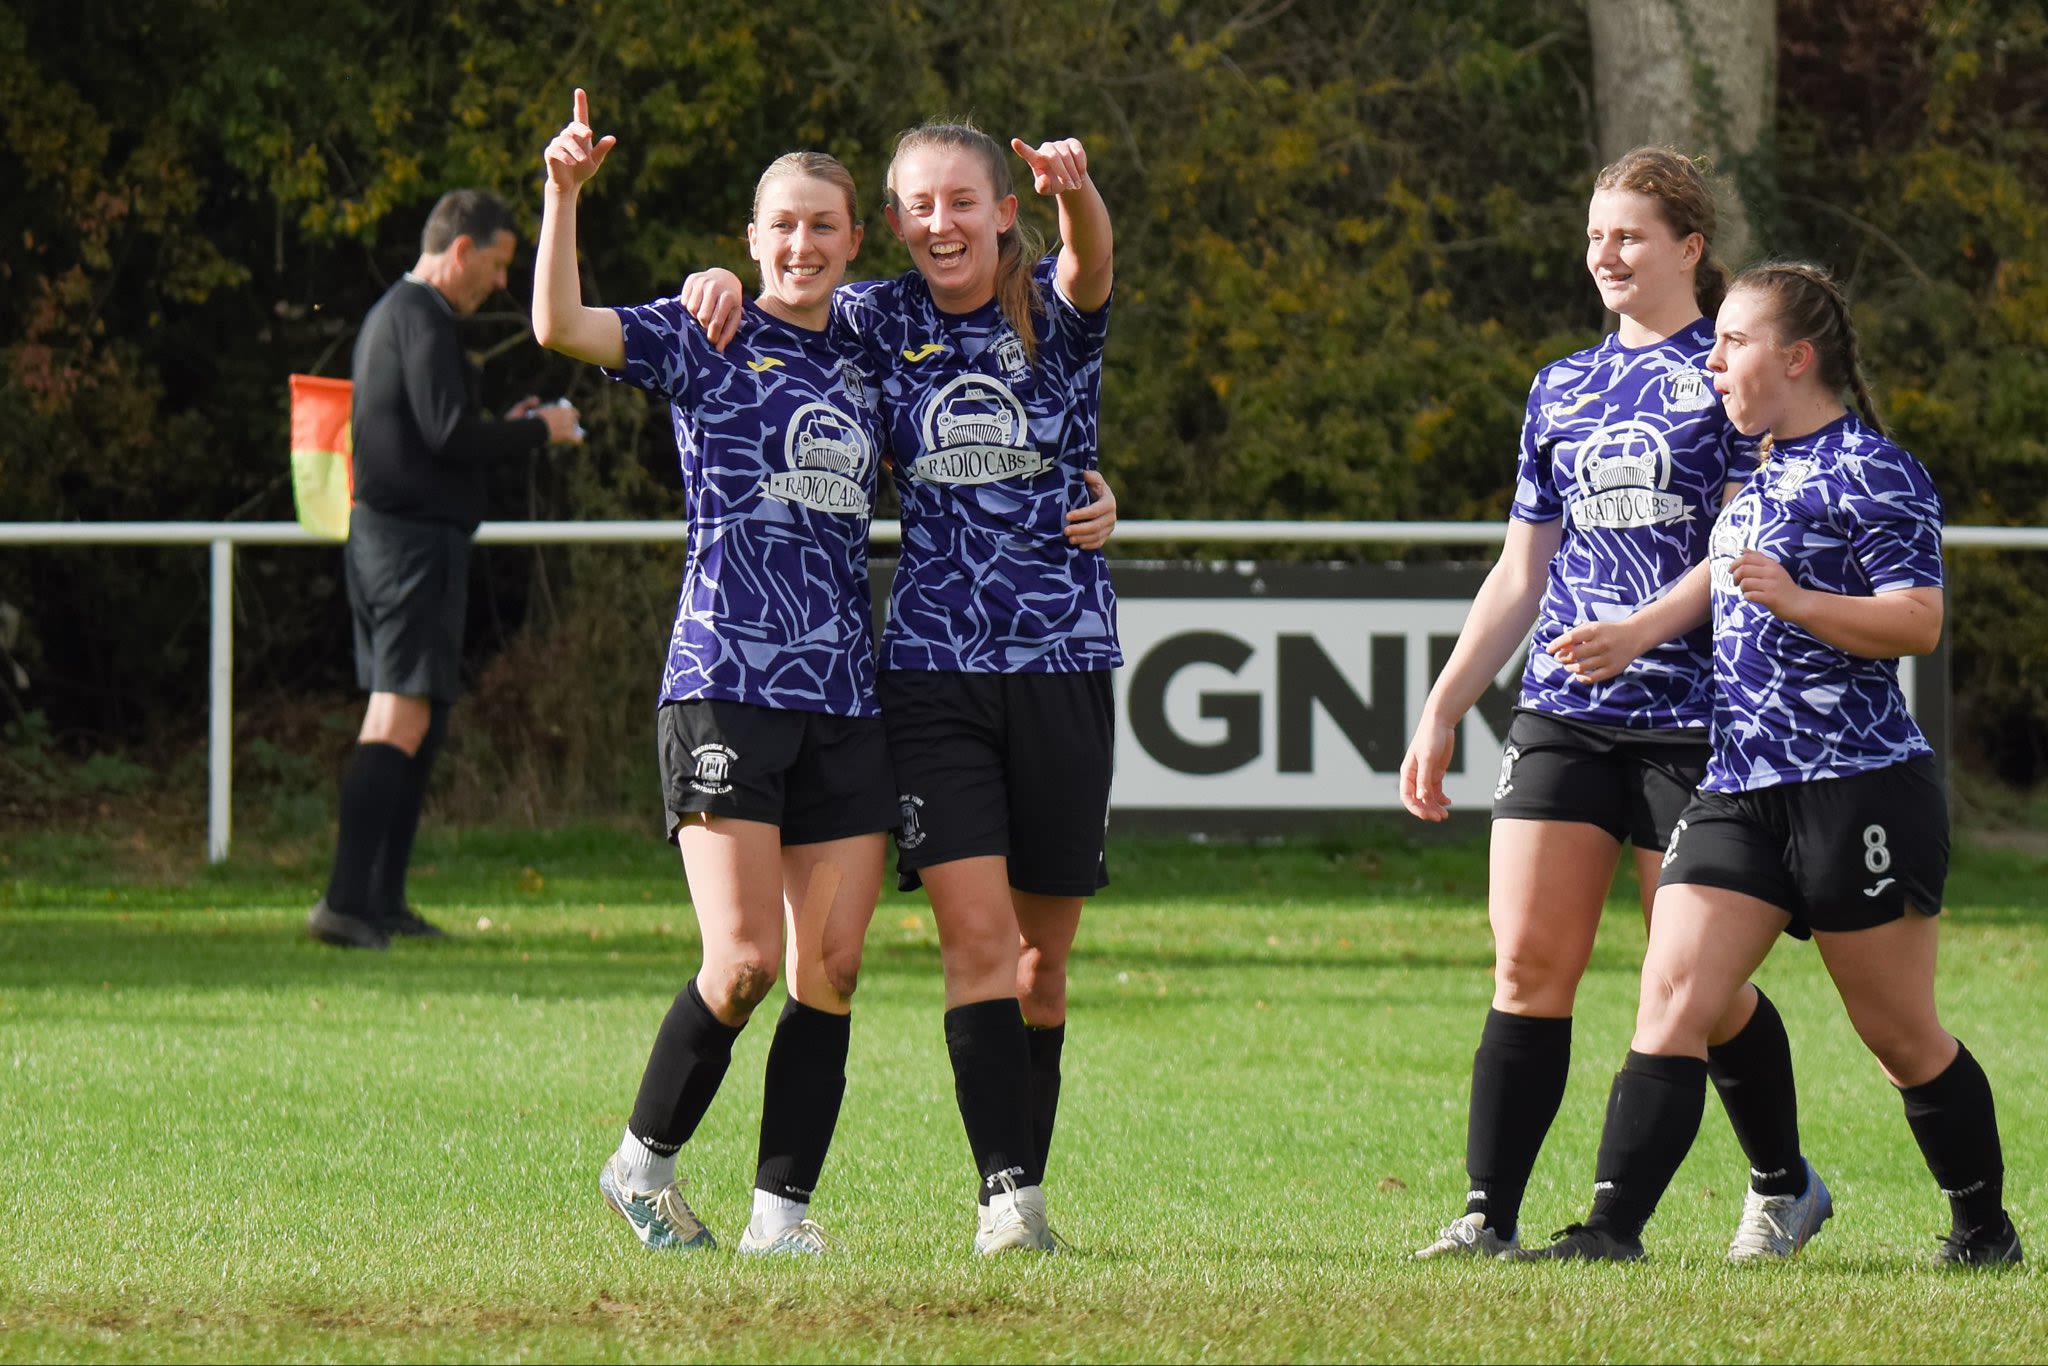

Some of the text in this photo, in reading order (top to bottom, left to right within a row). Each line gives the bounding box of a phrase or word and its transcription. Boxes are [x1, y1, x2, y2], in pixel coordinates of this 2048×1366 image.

[928, 451, 1027, 478] RADIO CABS
[785, 475, 863, 507] RADIO CABS
[1584, 494, 1670, 522] RADIO CABS
[1863, 824, 1891, 874] 8
